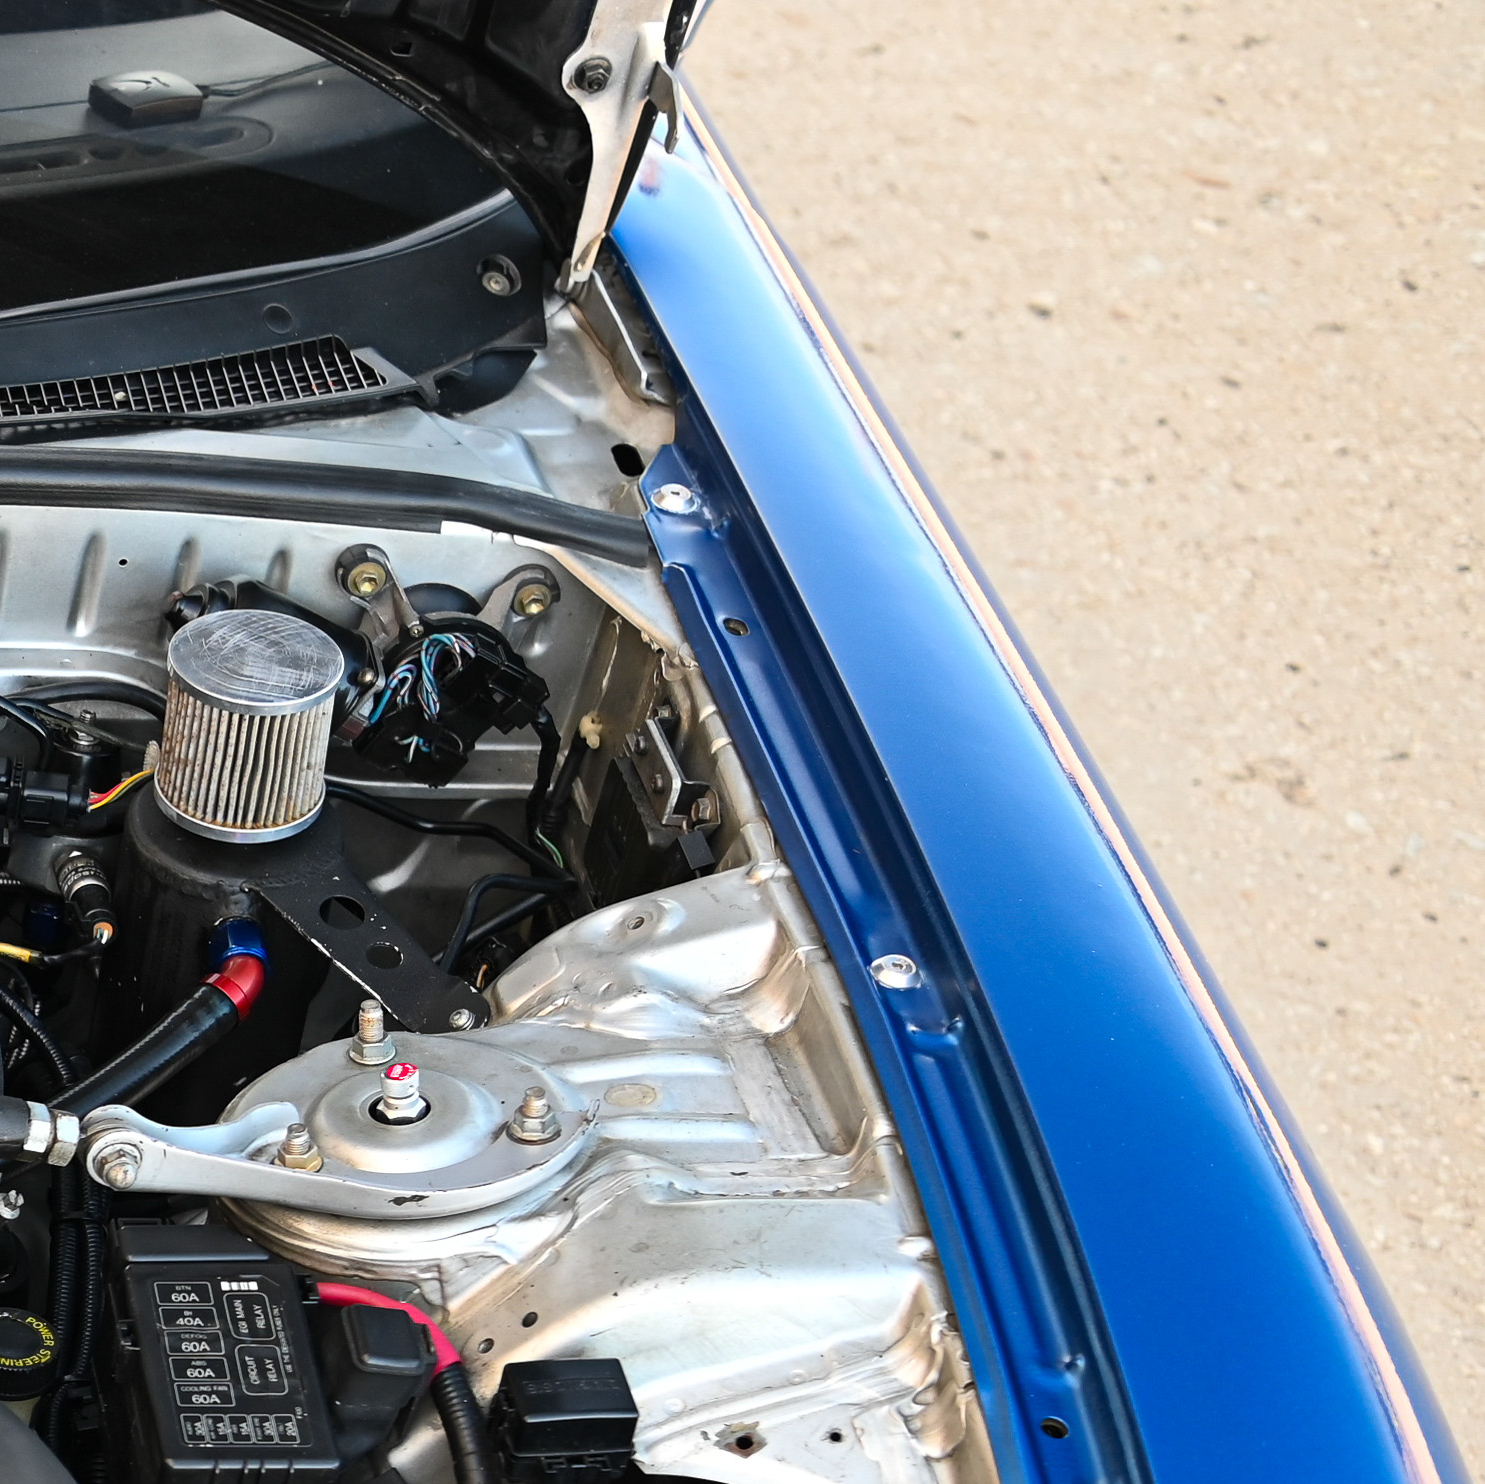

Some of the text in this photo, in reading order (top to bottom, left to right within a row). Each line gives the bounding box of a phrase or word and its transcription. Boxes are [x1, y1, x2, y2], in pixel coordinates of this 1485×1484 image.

[171, 1292, 200, 1302] 60A
[233, 1299, 245, 1319] MAIN
[253, 1304, 267, 1329] RELAY
[176, 1317, 204, 1326] 40A
[25, 1316, 55, 1346] POWER
[181, 1341, 211, 1352] 60A
[186, 1368, 215, 1378] 60A
[245, 1356, 261, 1385] CIRCUIT
[264, 1358, 278, 1382] RELAY
[191, 1394, 221, 1404] 60A
